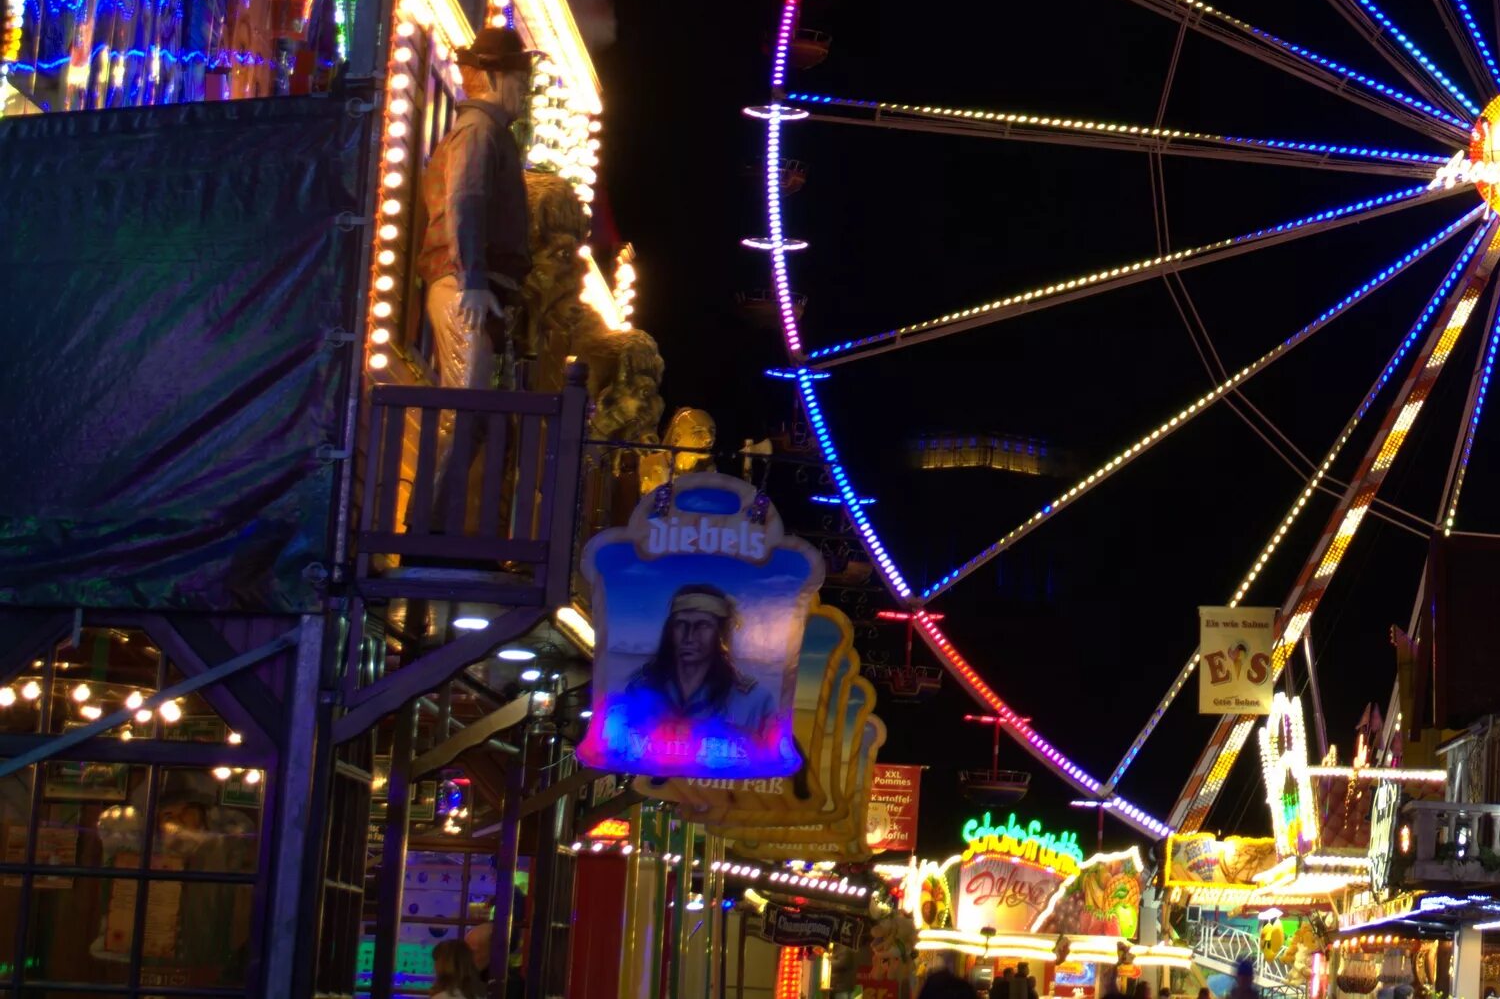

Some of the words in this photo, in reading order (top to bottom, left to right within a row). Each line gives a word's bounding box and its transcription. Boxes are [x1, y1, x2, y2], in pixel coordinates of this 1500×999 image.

[1242, 620, 1269, 628] Sahne
[885, 770, 901, 778] XXL
[874, 776, 911, 786] Pommes
[871, 794, 912, 804] Kartoffel-
